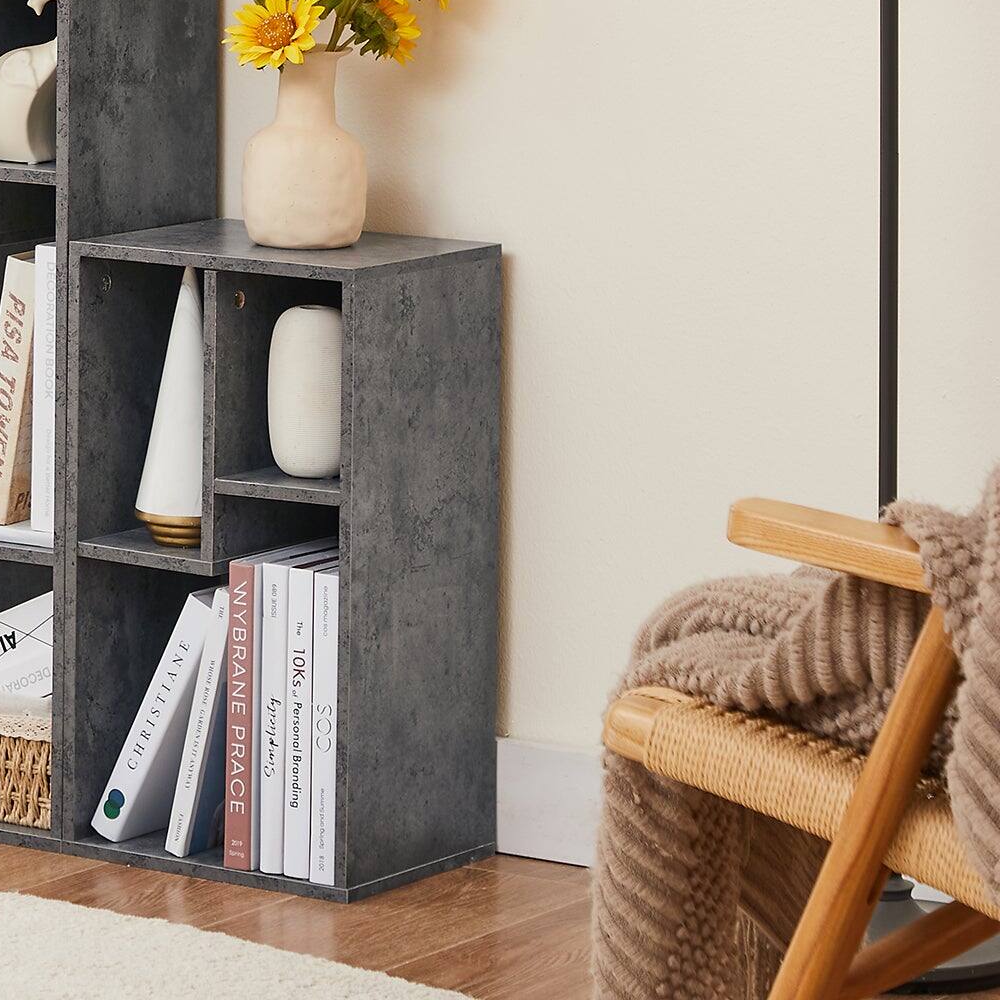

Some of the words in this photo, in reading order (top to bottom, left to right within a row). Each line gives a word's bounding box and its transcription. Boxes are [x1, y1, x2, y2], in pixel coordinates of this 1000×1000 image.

[1, 291, 26, 364] PISA
[45, 261, 56, 355] DECORATION
[44, 357, 55, 400] BOOK
[231, 581, 248, 715] WYBRANE
[296, 621, 304, 636] The
[292, 648, 306, 688] 10Ks
[292, 689, 298, 698] of
[127, 640, 191, 771] CHRISTIANE
[292, 702, 303, 752] Personal
[315, 703, 333, 753] COS
[264, 694, 282, 778] Simplicity
[230, 725, 246, 815] PRACE
[289, 754, 302, 809] Branding
